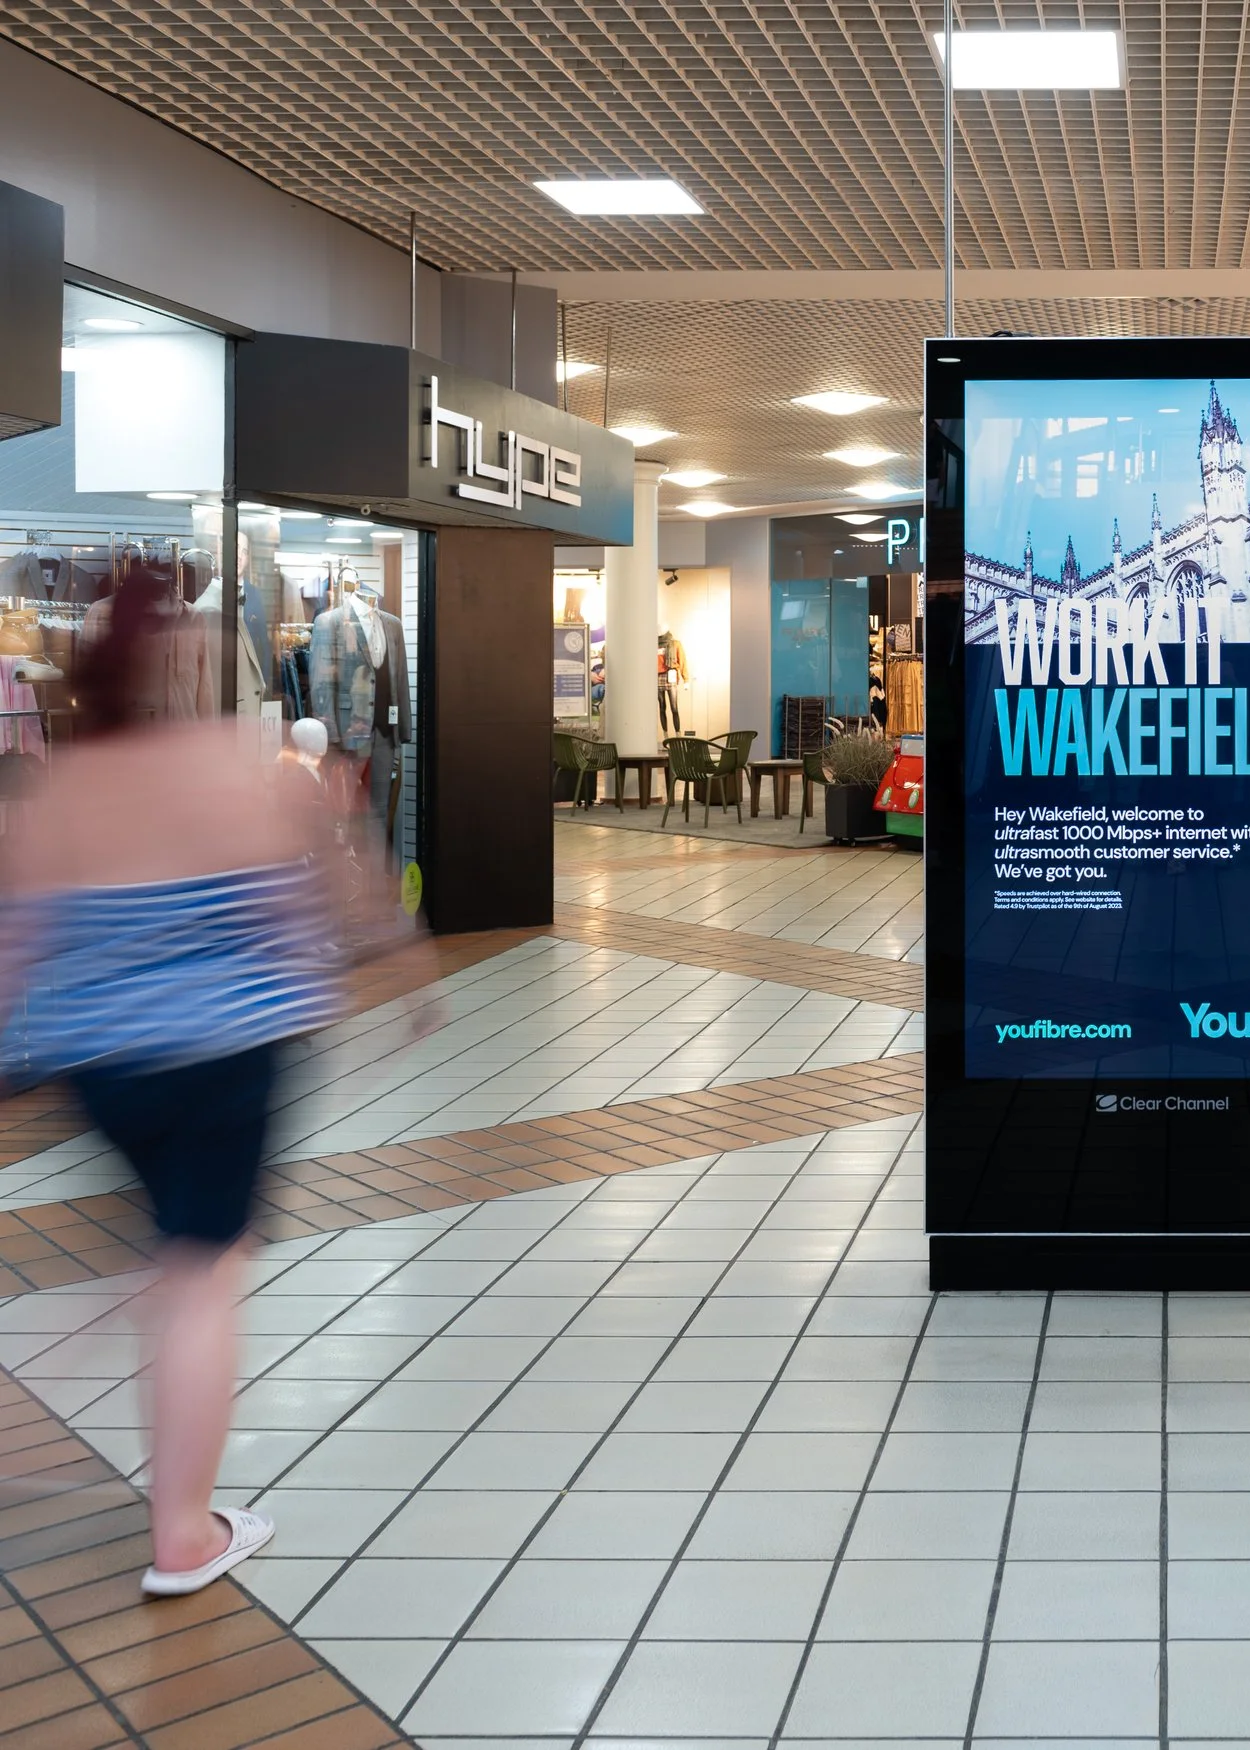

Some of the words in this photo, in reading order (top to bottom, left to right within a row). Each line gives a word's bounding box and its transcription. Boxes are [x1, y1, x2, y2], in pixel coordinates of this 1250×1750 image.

[431, 375, 582, 511] hype
[887, 518, 924, 565] P
[994, 598, 1170, 685] WORK
[1184, 597, 1229, 685] IT
[994, 806, 1026, 825] Hey
[1029, 806, 1109, 823] Wakefield,
[1112, 806, 1185, 821] welcome
[1187, 807, 1205, 821] to
[994, 825, 1060, 840] ultrafast
[1062, 825, 1104, 840] 1000
[1107, 825, 1163, 844] Mbps+
[1165, 824, 1228, 840] internet
[994, 844, 1091, 860] ultrasmooth
[1093, 846, 1171, 860] customer
[1045, 864, 1072, 883] got
[1074, 866, 1108, 882] you.
[995, 1019, 1132, 1043] youfibre.com
[1120, 1096, 1162, 1111] Clear
[1164, 1096, 1229, 1111] Channel
